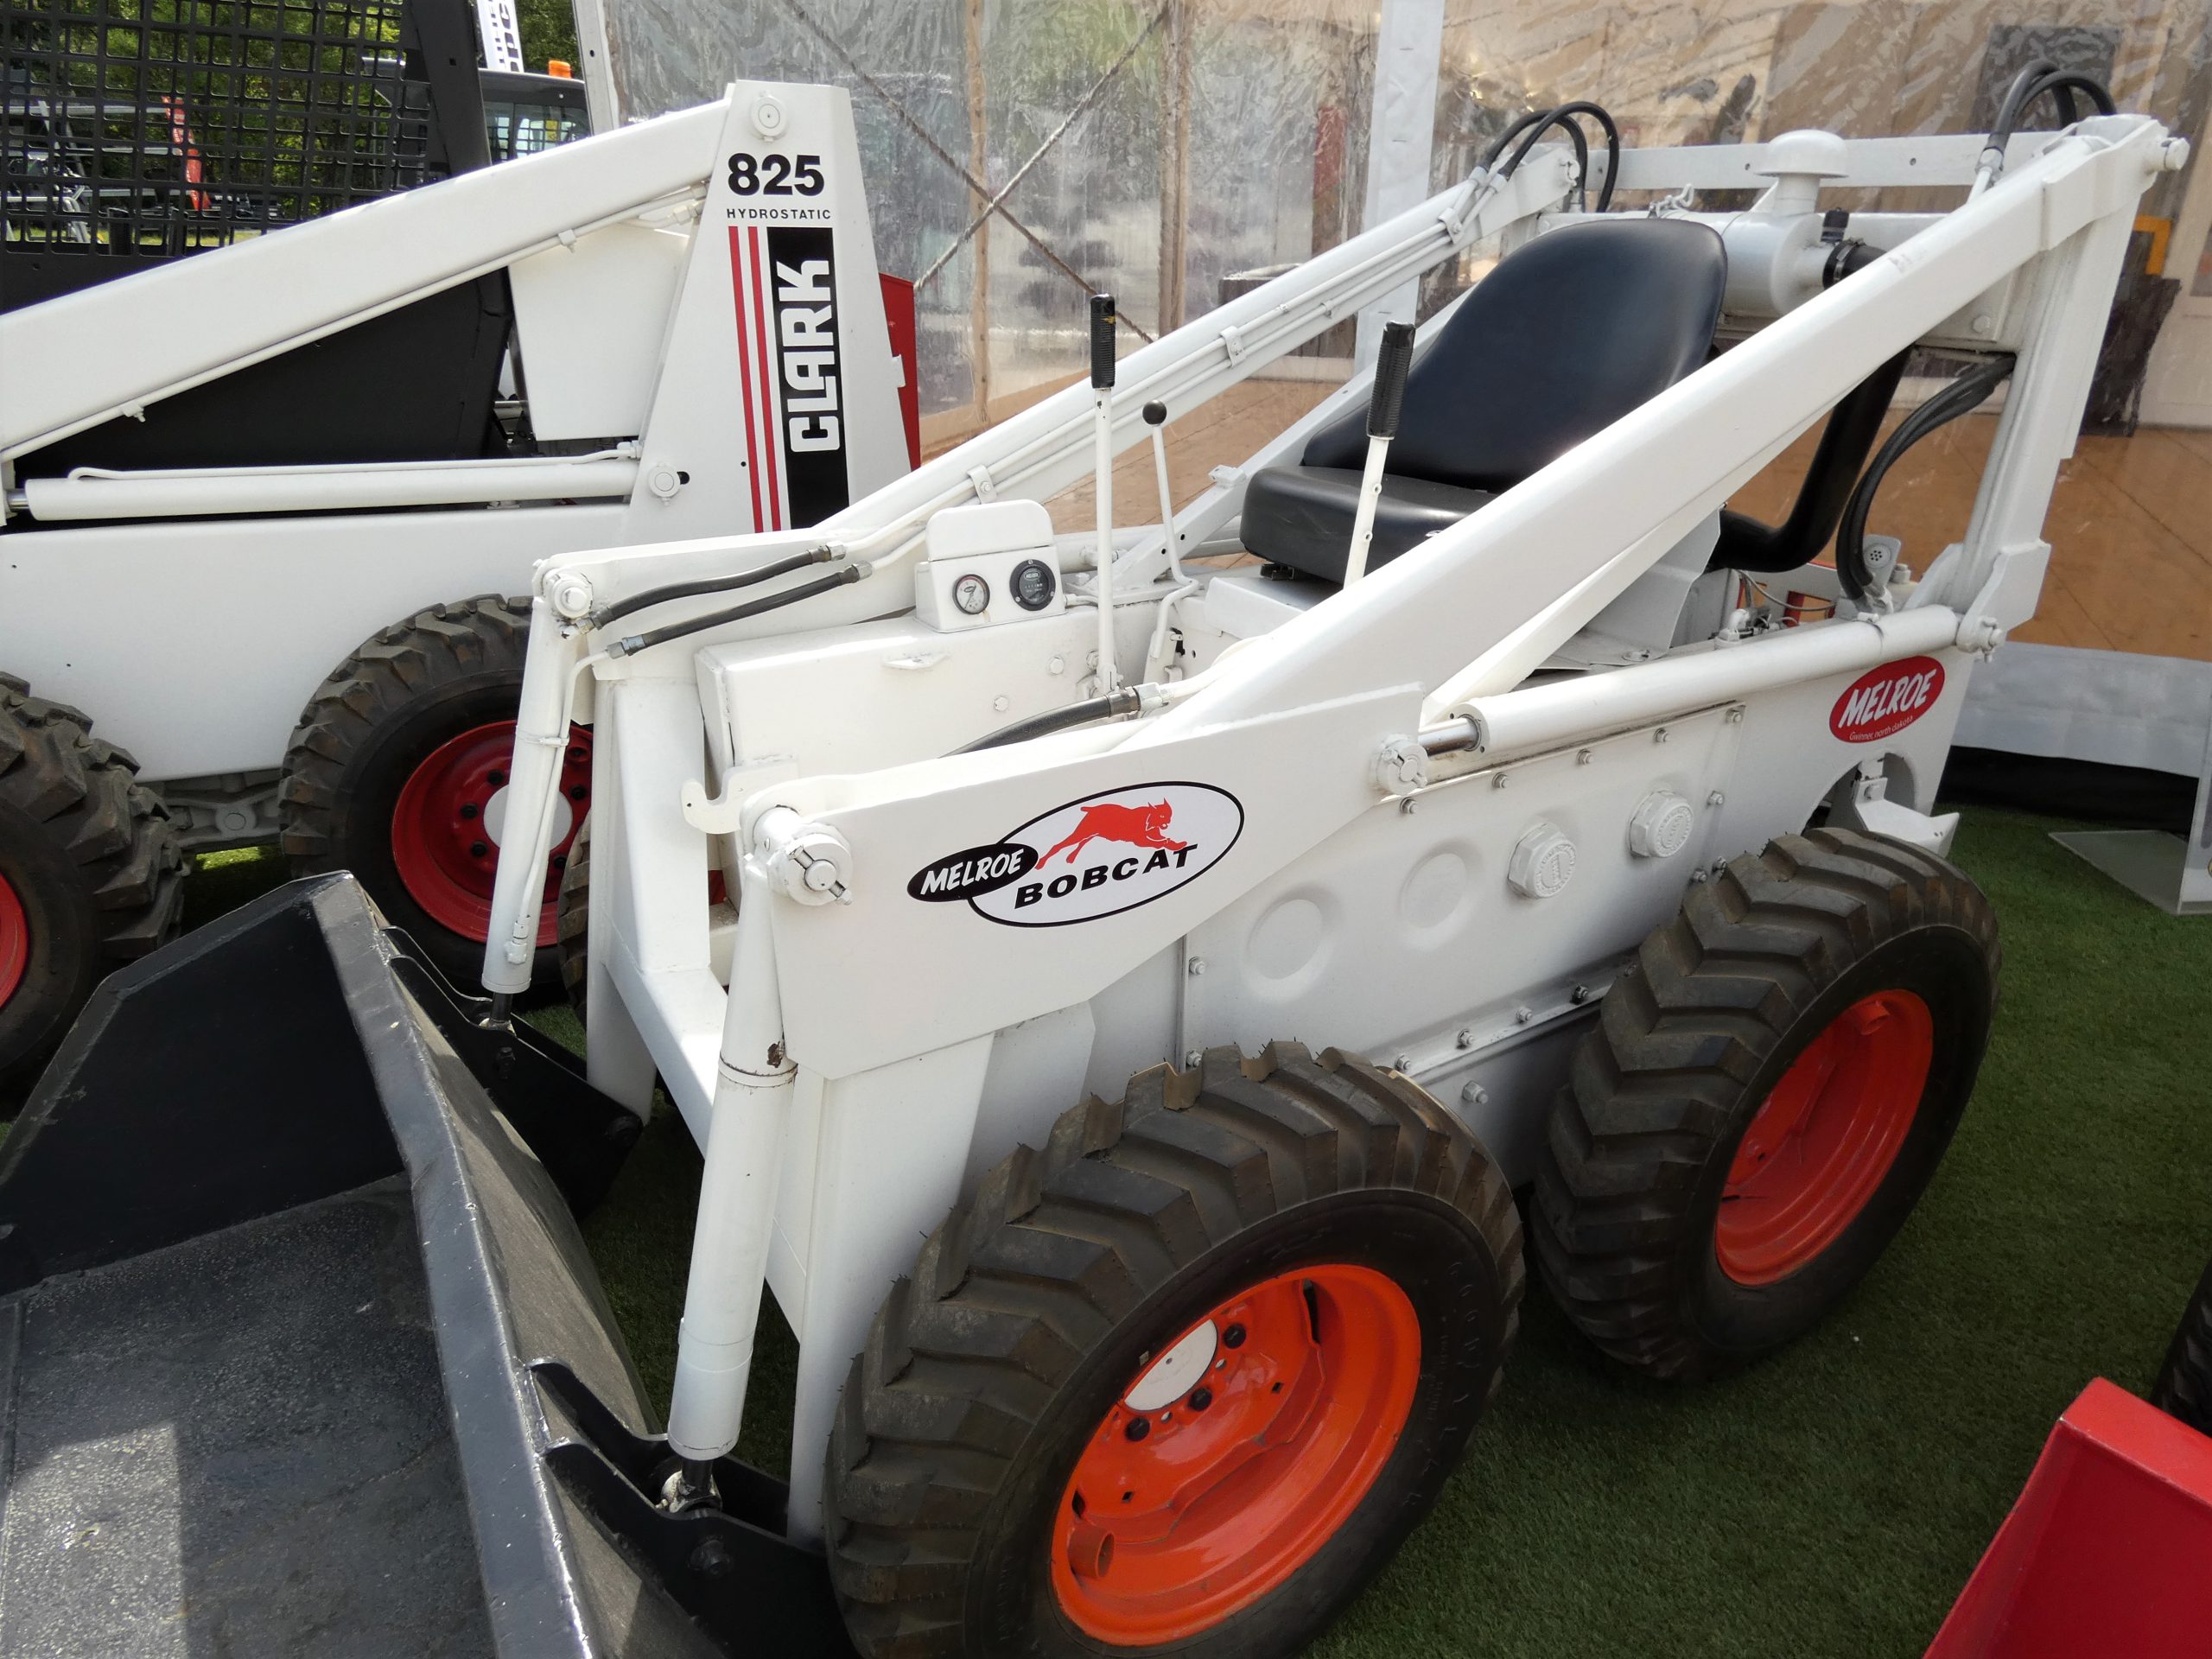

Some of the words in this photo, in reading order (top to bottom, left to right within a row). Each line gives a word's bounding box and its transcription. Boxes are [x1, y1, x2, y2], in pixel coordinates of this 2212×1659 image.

[728, 153, 824, 197] 825
[727, 208, 832, 220] HYDROSTATIC
[777, 259, 841, 453] CLARK
[1838, 669, 1937, 728] MELROE
[920, 848, 1025, 895] MELROE
[1014, 843, 1198, 909] BOBCAT
